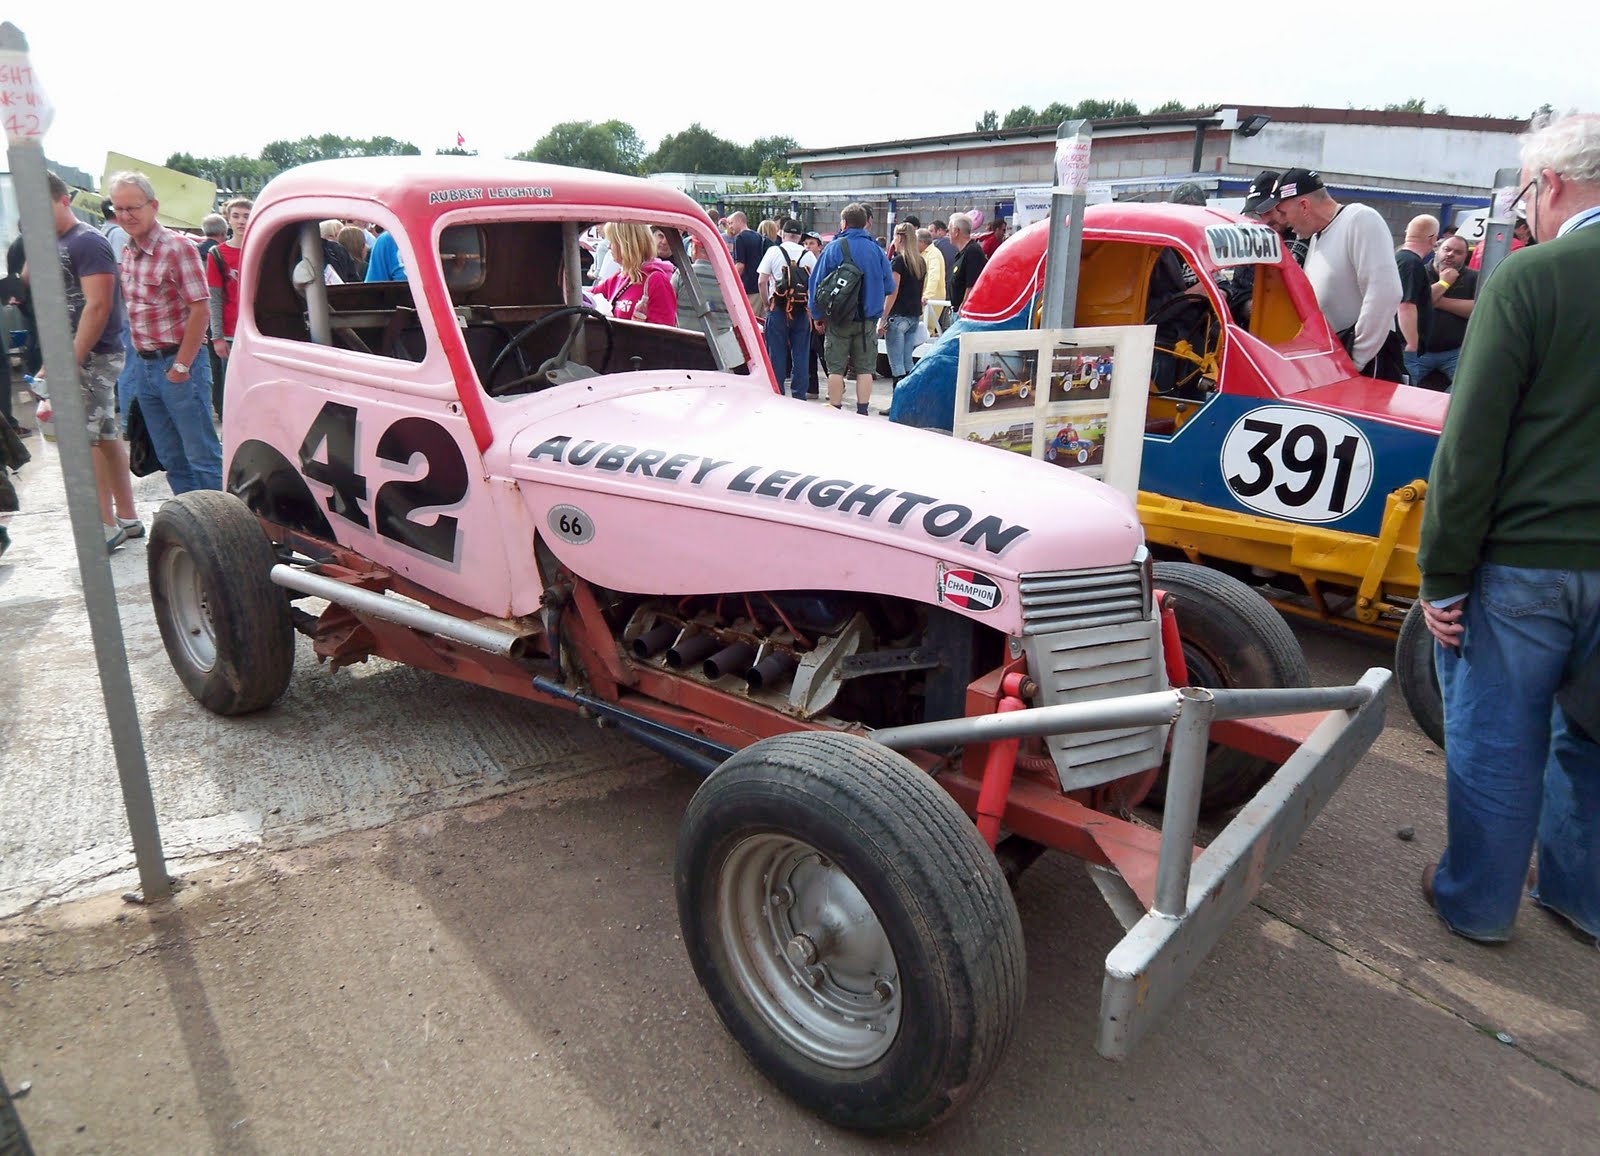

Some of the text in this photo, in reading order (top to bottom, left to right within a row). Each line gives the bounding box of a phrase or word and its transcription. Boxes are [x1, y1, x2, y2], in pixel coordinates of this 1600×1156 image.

[5, 114, 41, 136] 42
[429, 187, 553, 205] AUBREY LEIGHTON
[1206, 227, 1278, 259] WILDCAT
[1228, 418, 1360, 514] 391
[298, 400, 469, 568] 42
[527, 434, 1030, 557] AUBREY LEIGHTON
[559, 514, 582, 536] 66
[947, 580, 994, 601] CHAMPION
